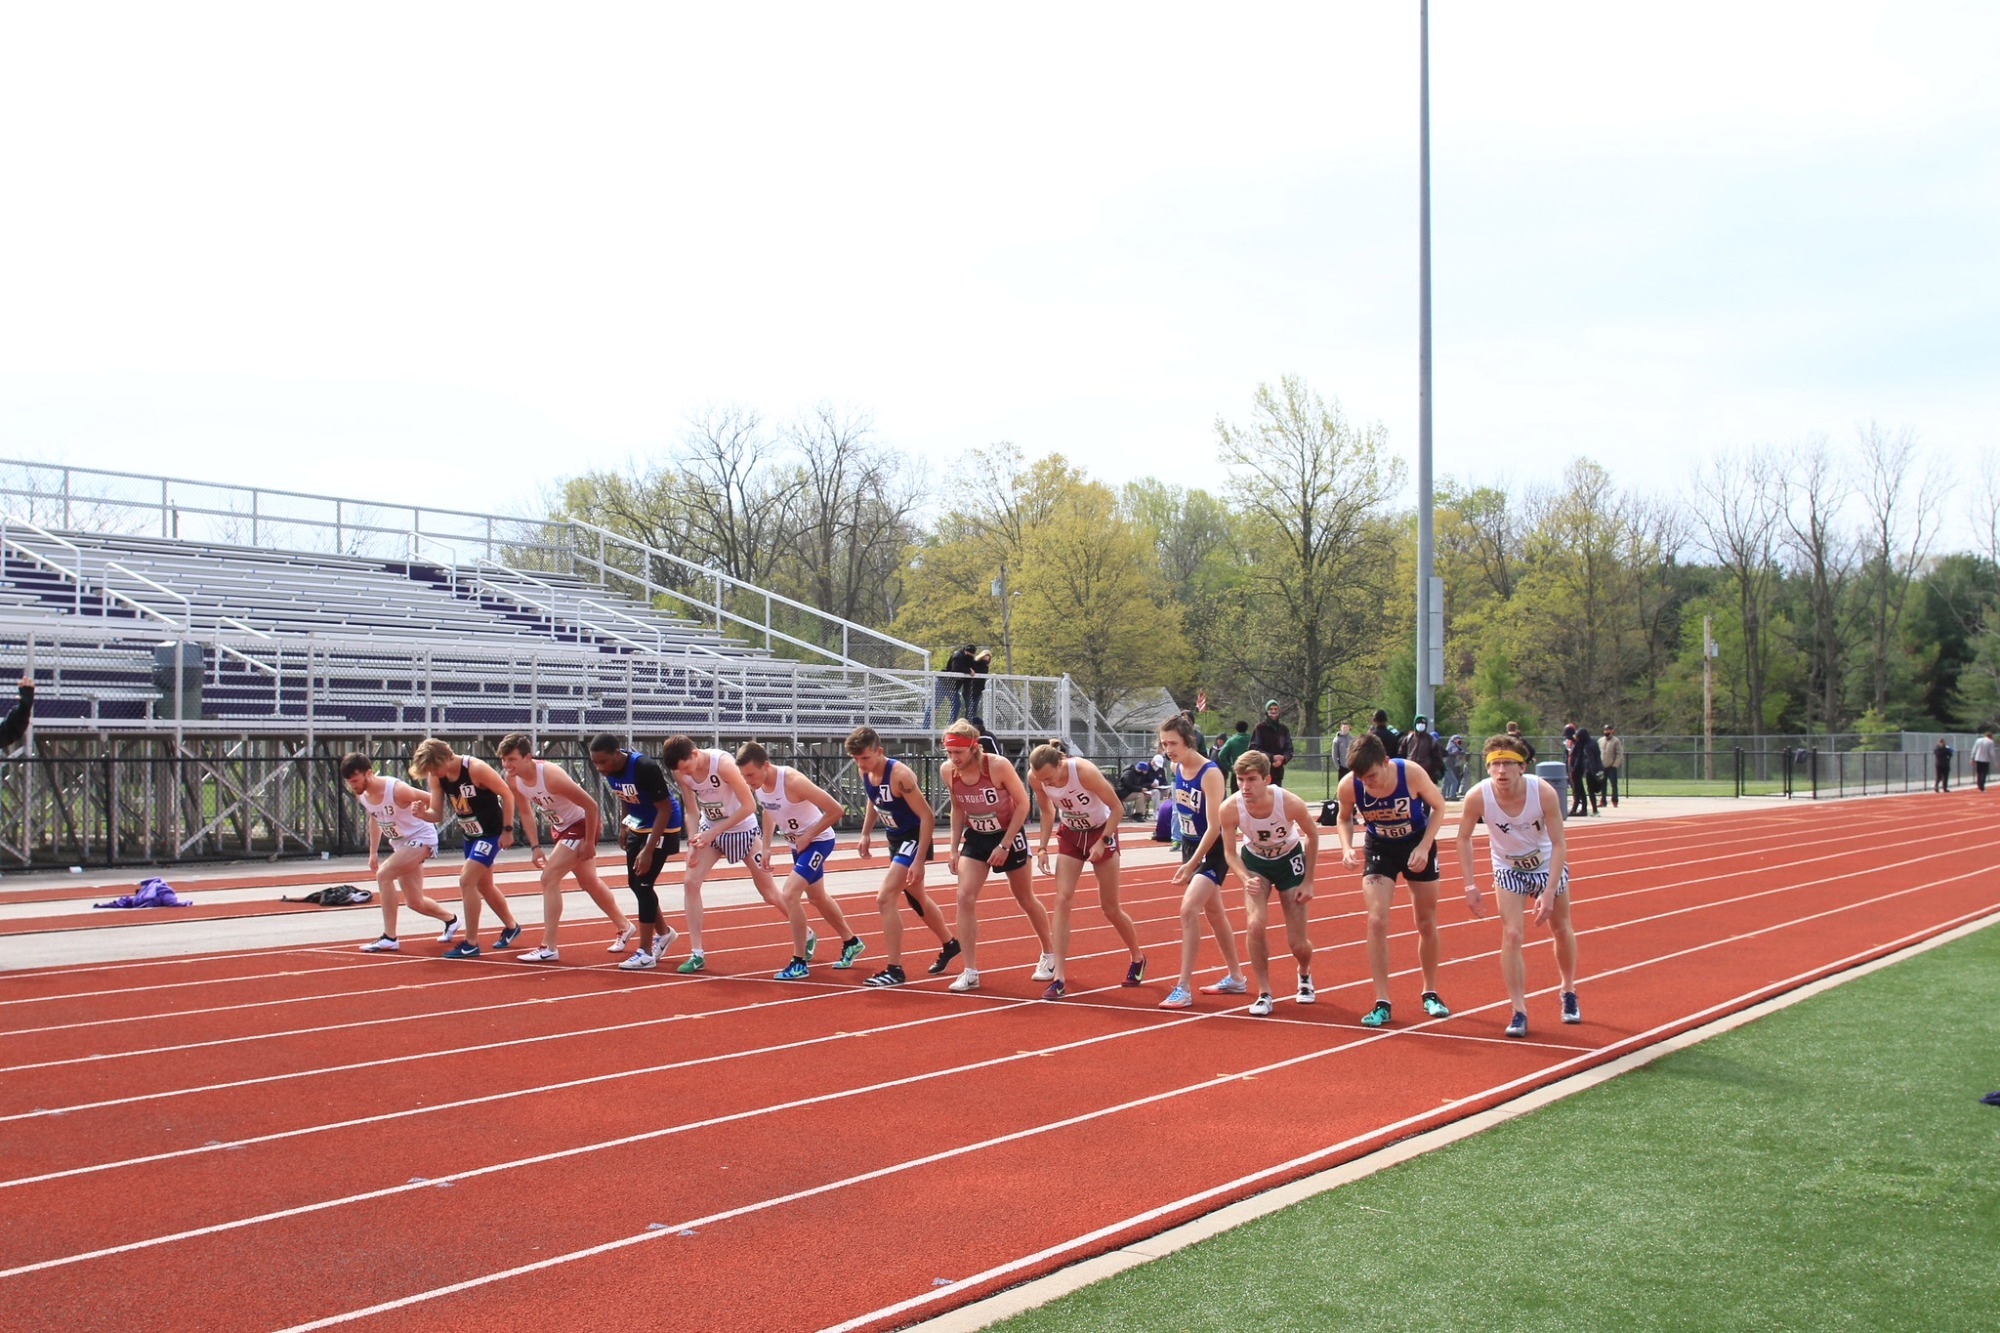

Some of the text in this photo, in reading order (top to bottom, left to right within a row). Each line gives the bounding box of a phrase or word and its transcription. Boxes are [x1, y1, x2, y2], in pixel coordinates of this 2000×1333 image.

[710, 774, 721, 788] 9
[462, 786, 473, 796] 12
[625, 784, 635, 796] 10
[880, 786, 888, 800] 7
[542, 796, 554, 804] 11
[985, 789, 997, 804] 6
[1076, 793, 1090, 806] 5
[1191, 791, 1199, 806] 4
[384, 805, 394, 815] 13
[1396, 799, 1408, 813] 2
[788, 818, 799, 830] 8
[973, 819, 996, 831] 273
[1067, 818, 1091, 829] 239
[1532, 820, 1541, 831] 1
[1257, 830, 1271, 841] P
[1275, 826, 1287, 838] 3
[1381, 827, 1407, 837] 160
[478, 841, 490, 853] 12
[902, 841, 913, 852] 7
[1013, 835, 1024, 850] 6
[811, 854, 821, 868] 8
[1292, 857, 1304, 873] 3
